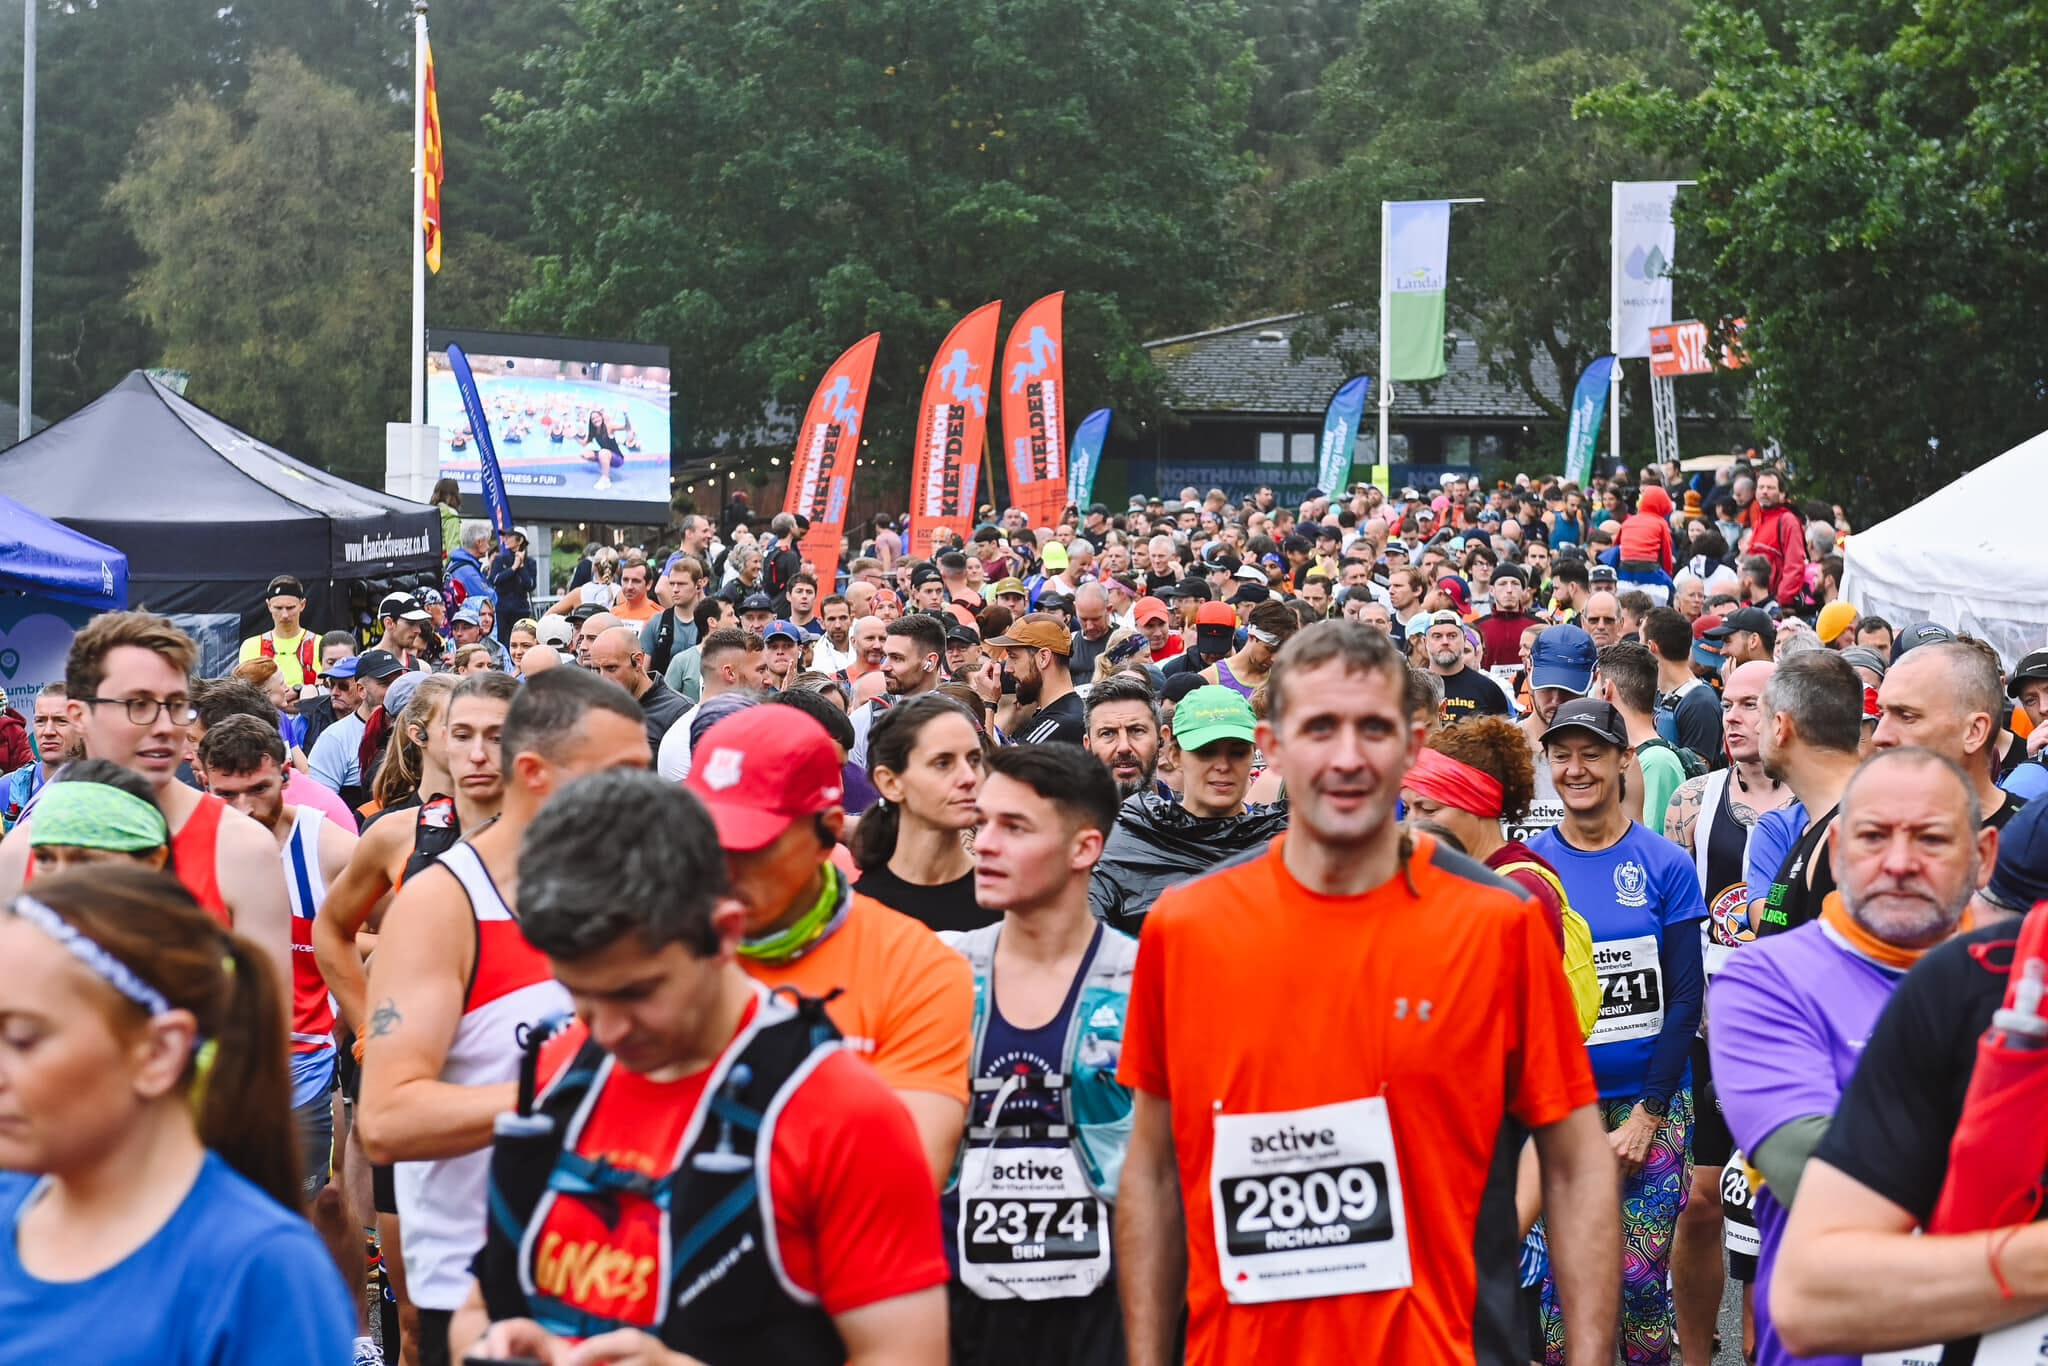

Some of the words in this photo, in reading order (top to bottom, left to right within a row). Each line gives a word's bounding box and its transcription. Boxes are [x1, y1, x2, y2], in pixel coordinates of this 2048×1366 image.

[1396, 276, 1443, 289] Landal
[1027, 381, 1048, 481] KIELDER
[1042, 379, 1060, 481] MARATHON
[1333, 415, 1348, 454] water
[501, 474, 532, 484] ITNESS
[539, 476, 557, 485] FUN
[1077, 447, 1089, 485] water
[1326, 453, 1347, 494] living
[344, 527, 431, 563] www.flanciactivewear.co.uk
[6, 682, 46, 696] umbri
[1447, 697, 1476, 709] ning
[1528, 804, 1565, 817] ctive
[1714, 888, 1748, 918] NEWC
[1592, 948, 1632, 964] ctive
[1597, 972, 1648, 1002] 741
[1250, 1125, 1336, 1154] active
[992, 1160, 1064, 1181] active
[1233, 1166, 1379, 1233] 2809
[1723, 1172, 1757, 1210] 28
[972, 1201, 1089, 1245] 2374
[1264, 1223, 1351, 1250] RICHARD
[1011, 1244, 1046, 1260] BEN
